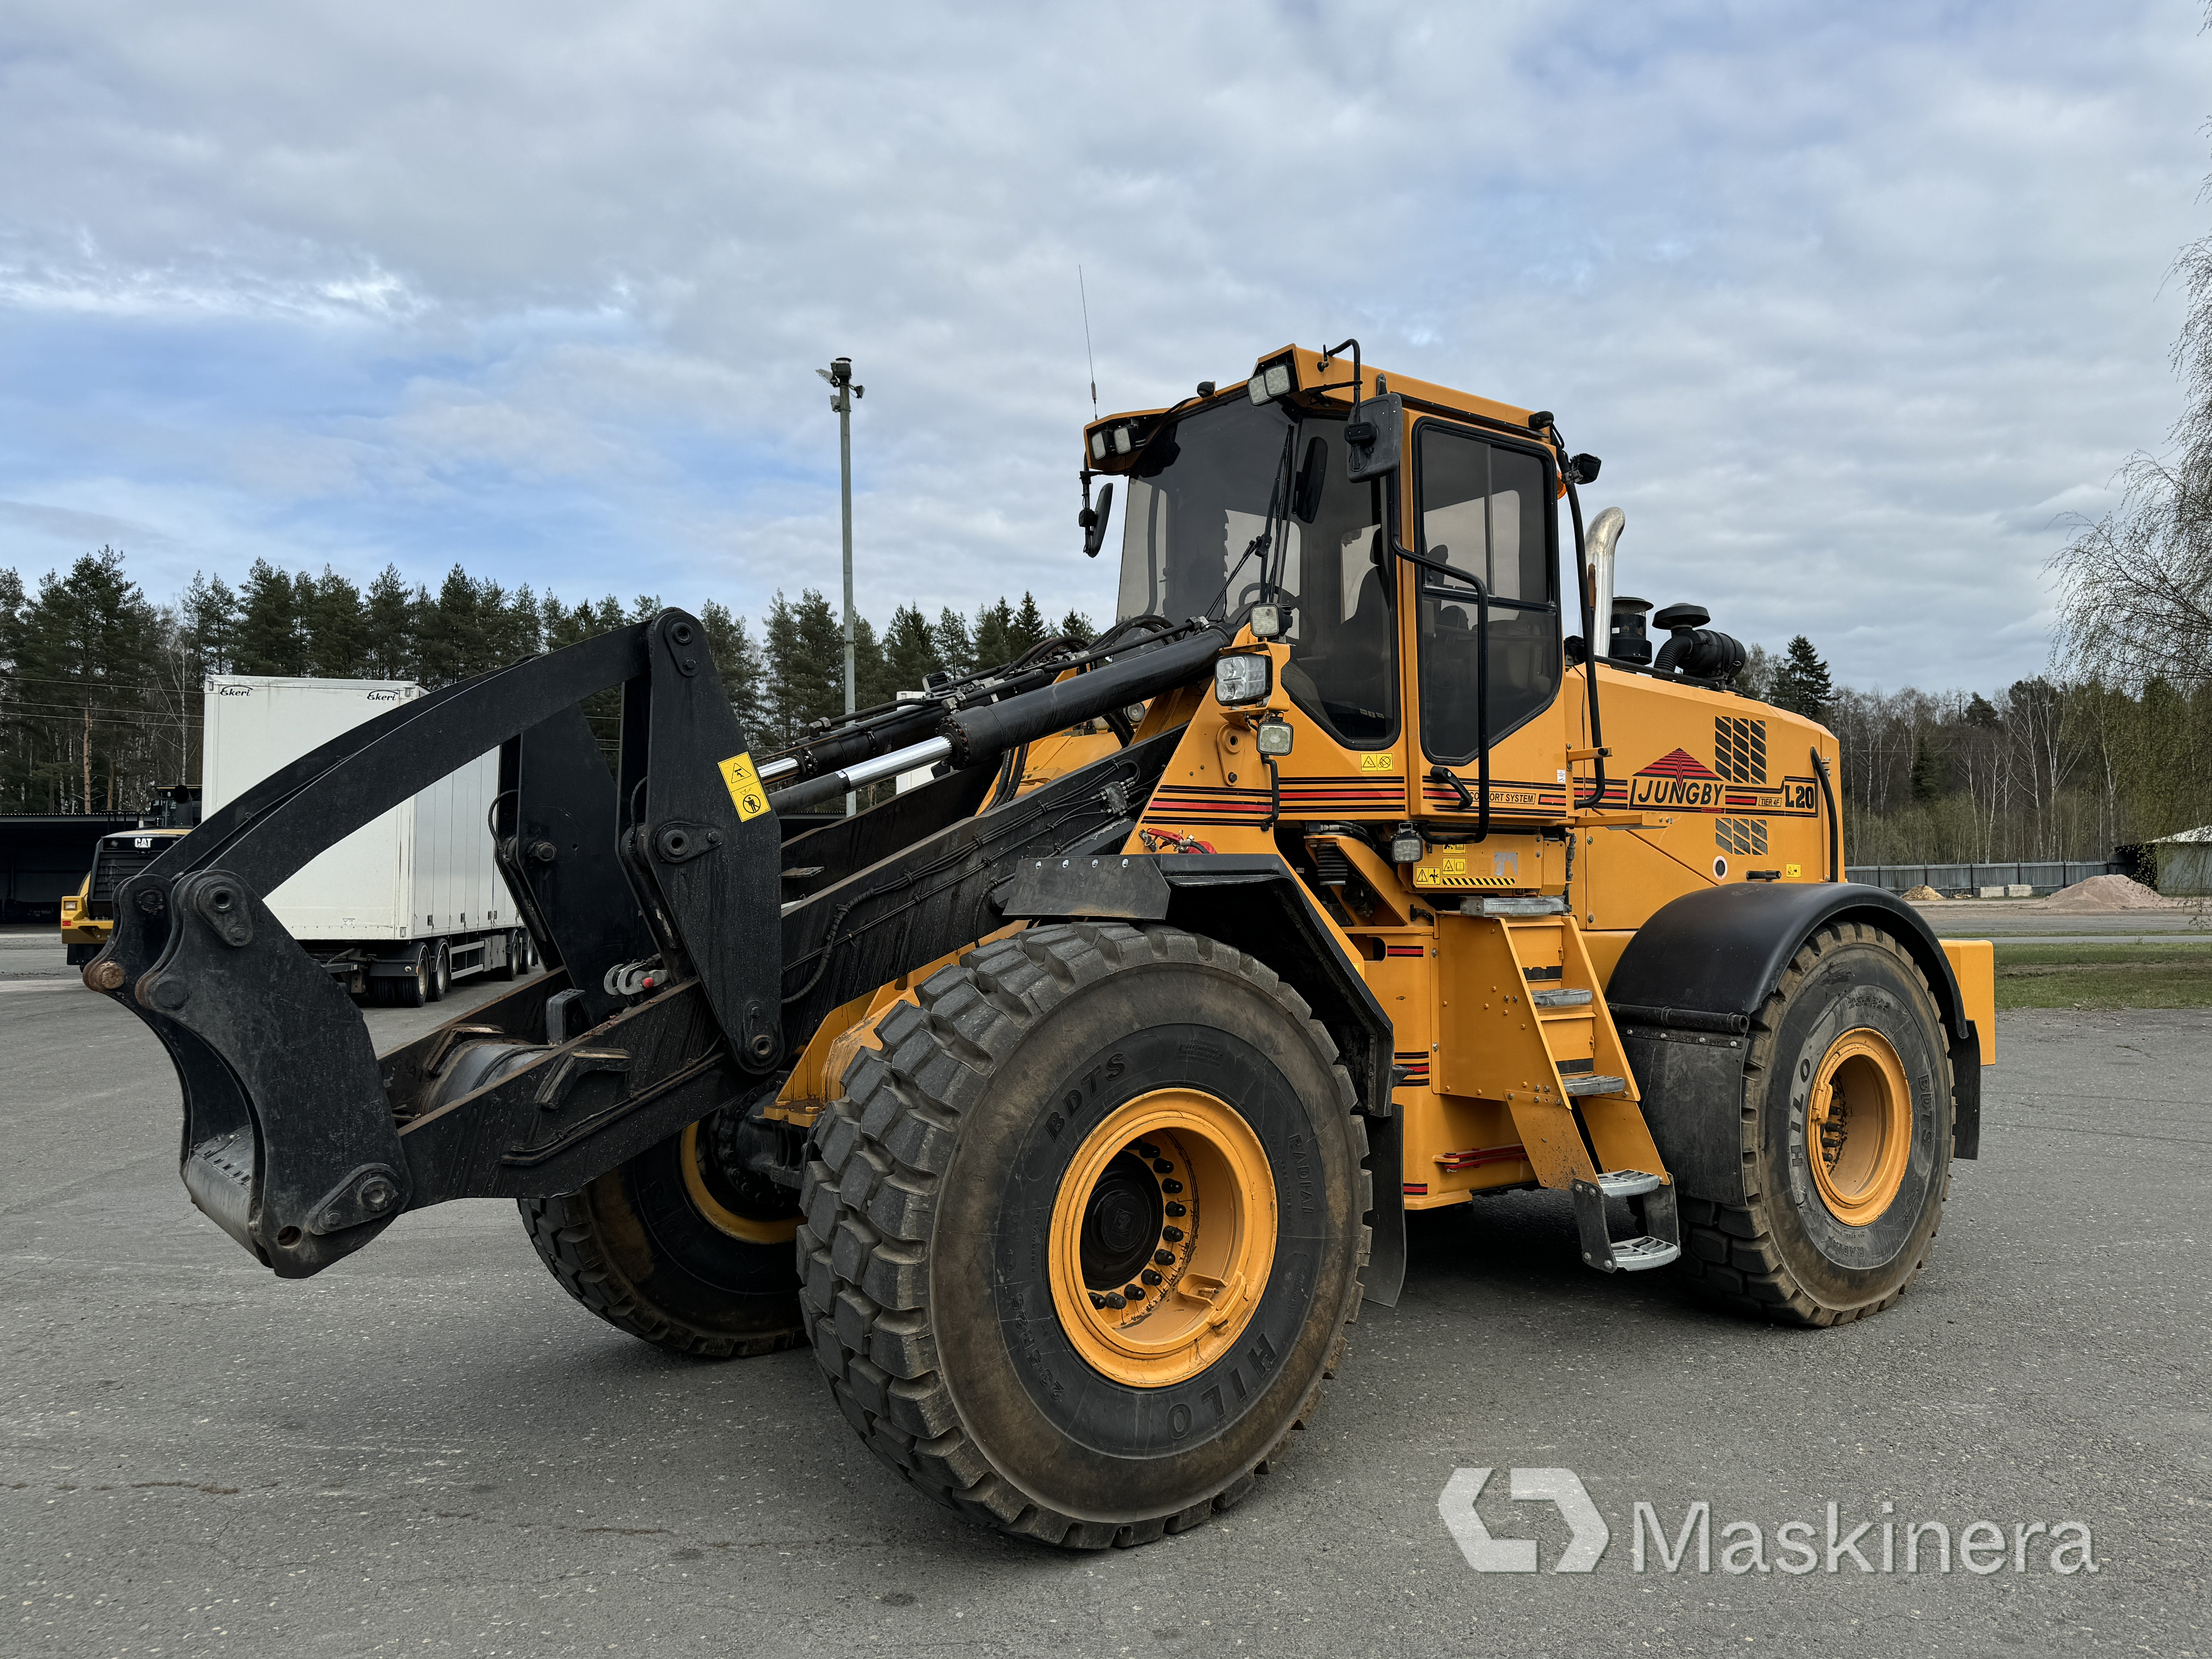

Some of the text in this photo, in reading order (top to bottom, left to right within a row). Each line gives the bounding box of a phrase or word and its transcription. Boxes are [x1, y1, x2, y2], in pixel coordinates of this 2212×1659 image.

[220, 685, 253, 696] Ekeri
[367, 690, 398, 701] Ekeri
[1470, 792, 1533, 803] COORT SYSTEM
[1785, 785, 1814, 809] L20
[135, 838, 153, 848] CAT
[1044, 1052, 1125, 1143] BDTS
[1790, 1058, 1810, 1167] HILO
[1918, 1074, 1933, 1147] BDTS
[1289, 1133, 1314, 1219] RADIAL
[1011, 1293, 1064, 1400] 23.5R25
[1166, 1332, 1277, 1440] HILO
